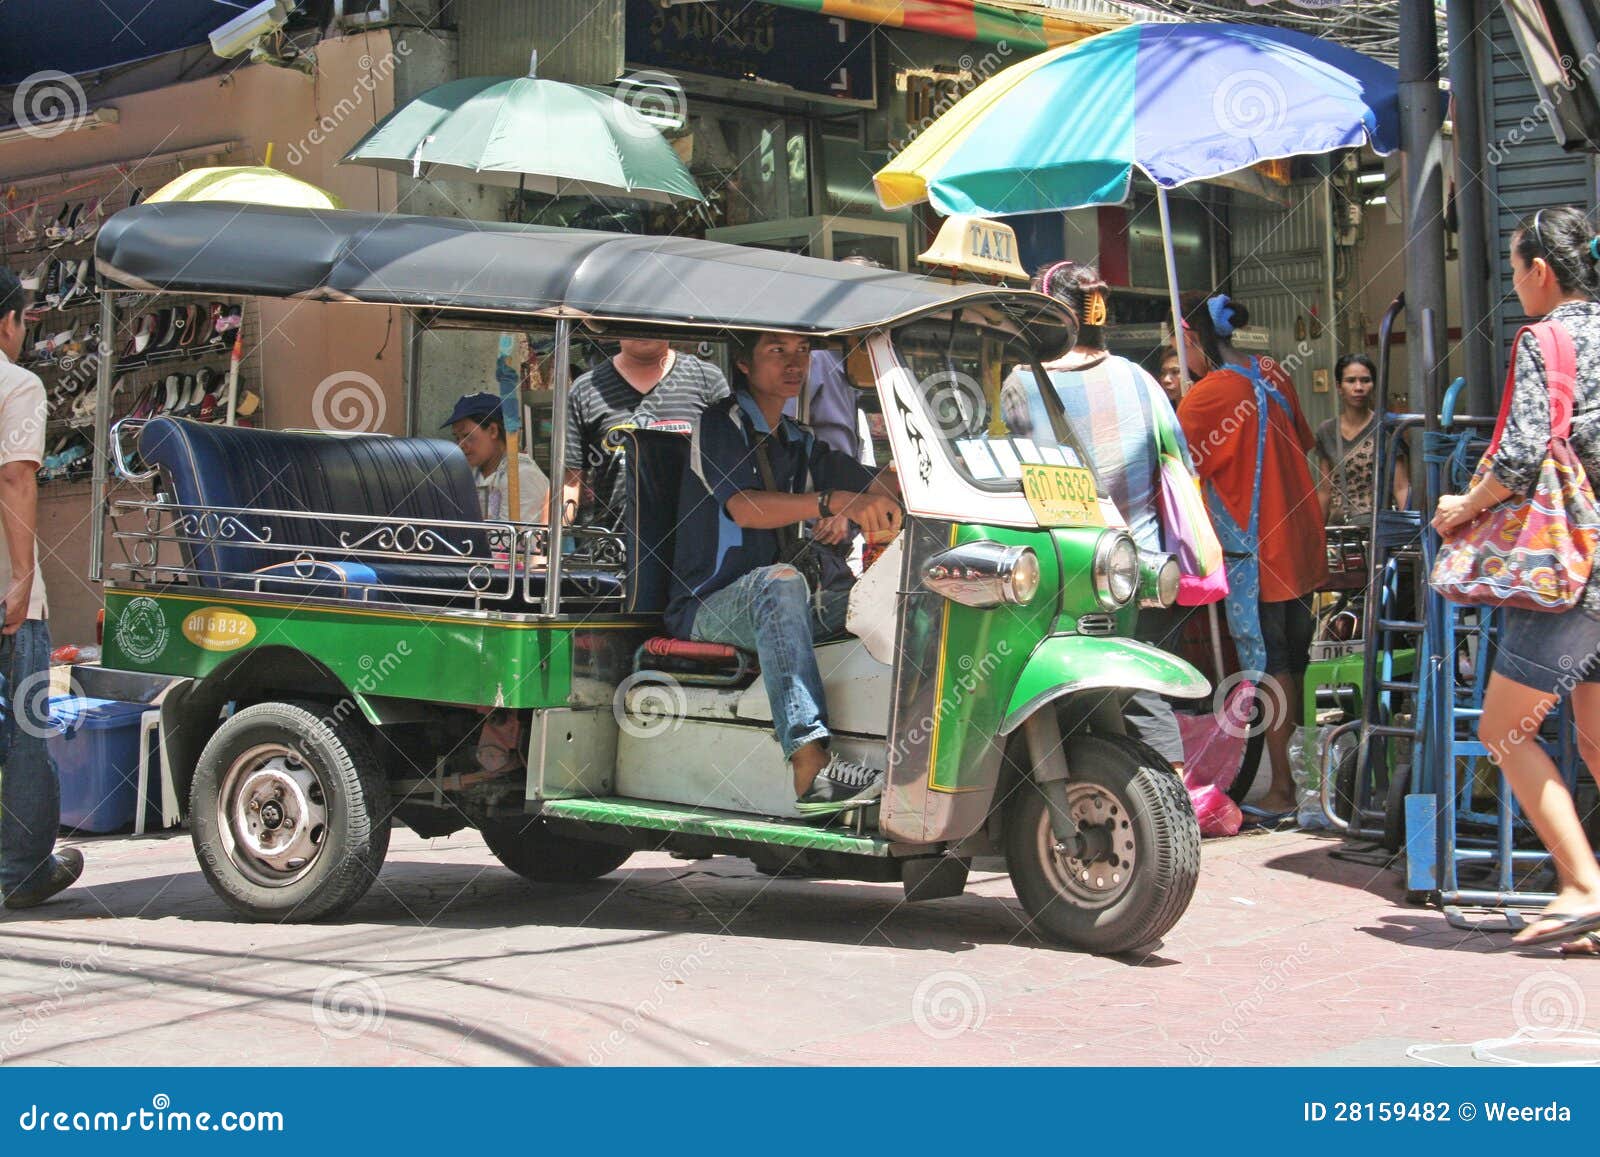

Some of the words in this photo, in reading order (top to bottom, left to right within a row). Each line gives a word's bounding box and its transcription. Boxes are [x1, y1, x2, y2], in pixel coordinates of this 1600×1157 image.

[969, 223, 1012, 264] TAXI
[1055, 471, 1095, 503] 6832
[207, 616, 248, 635] 6832
